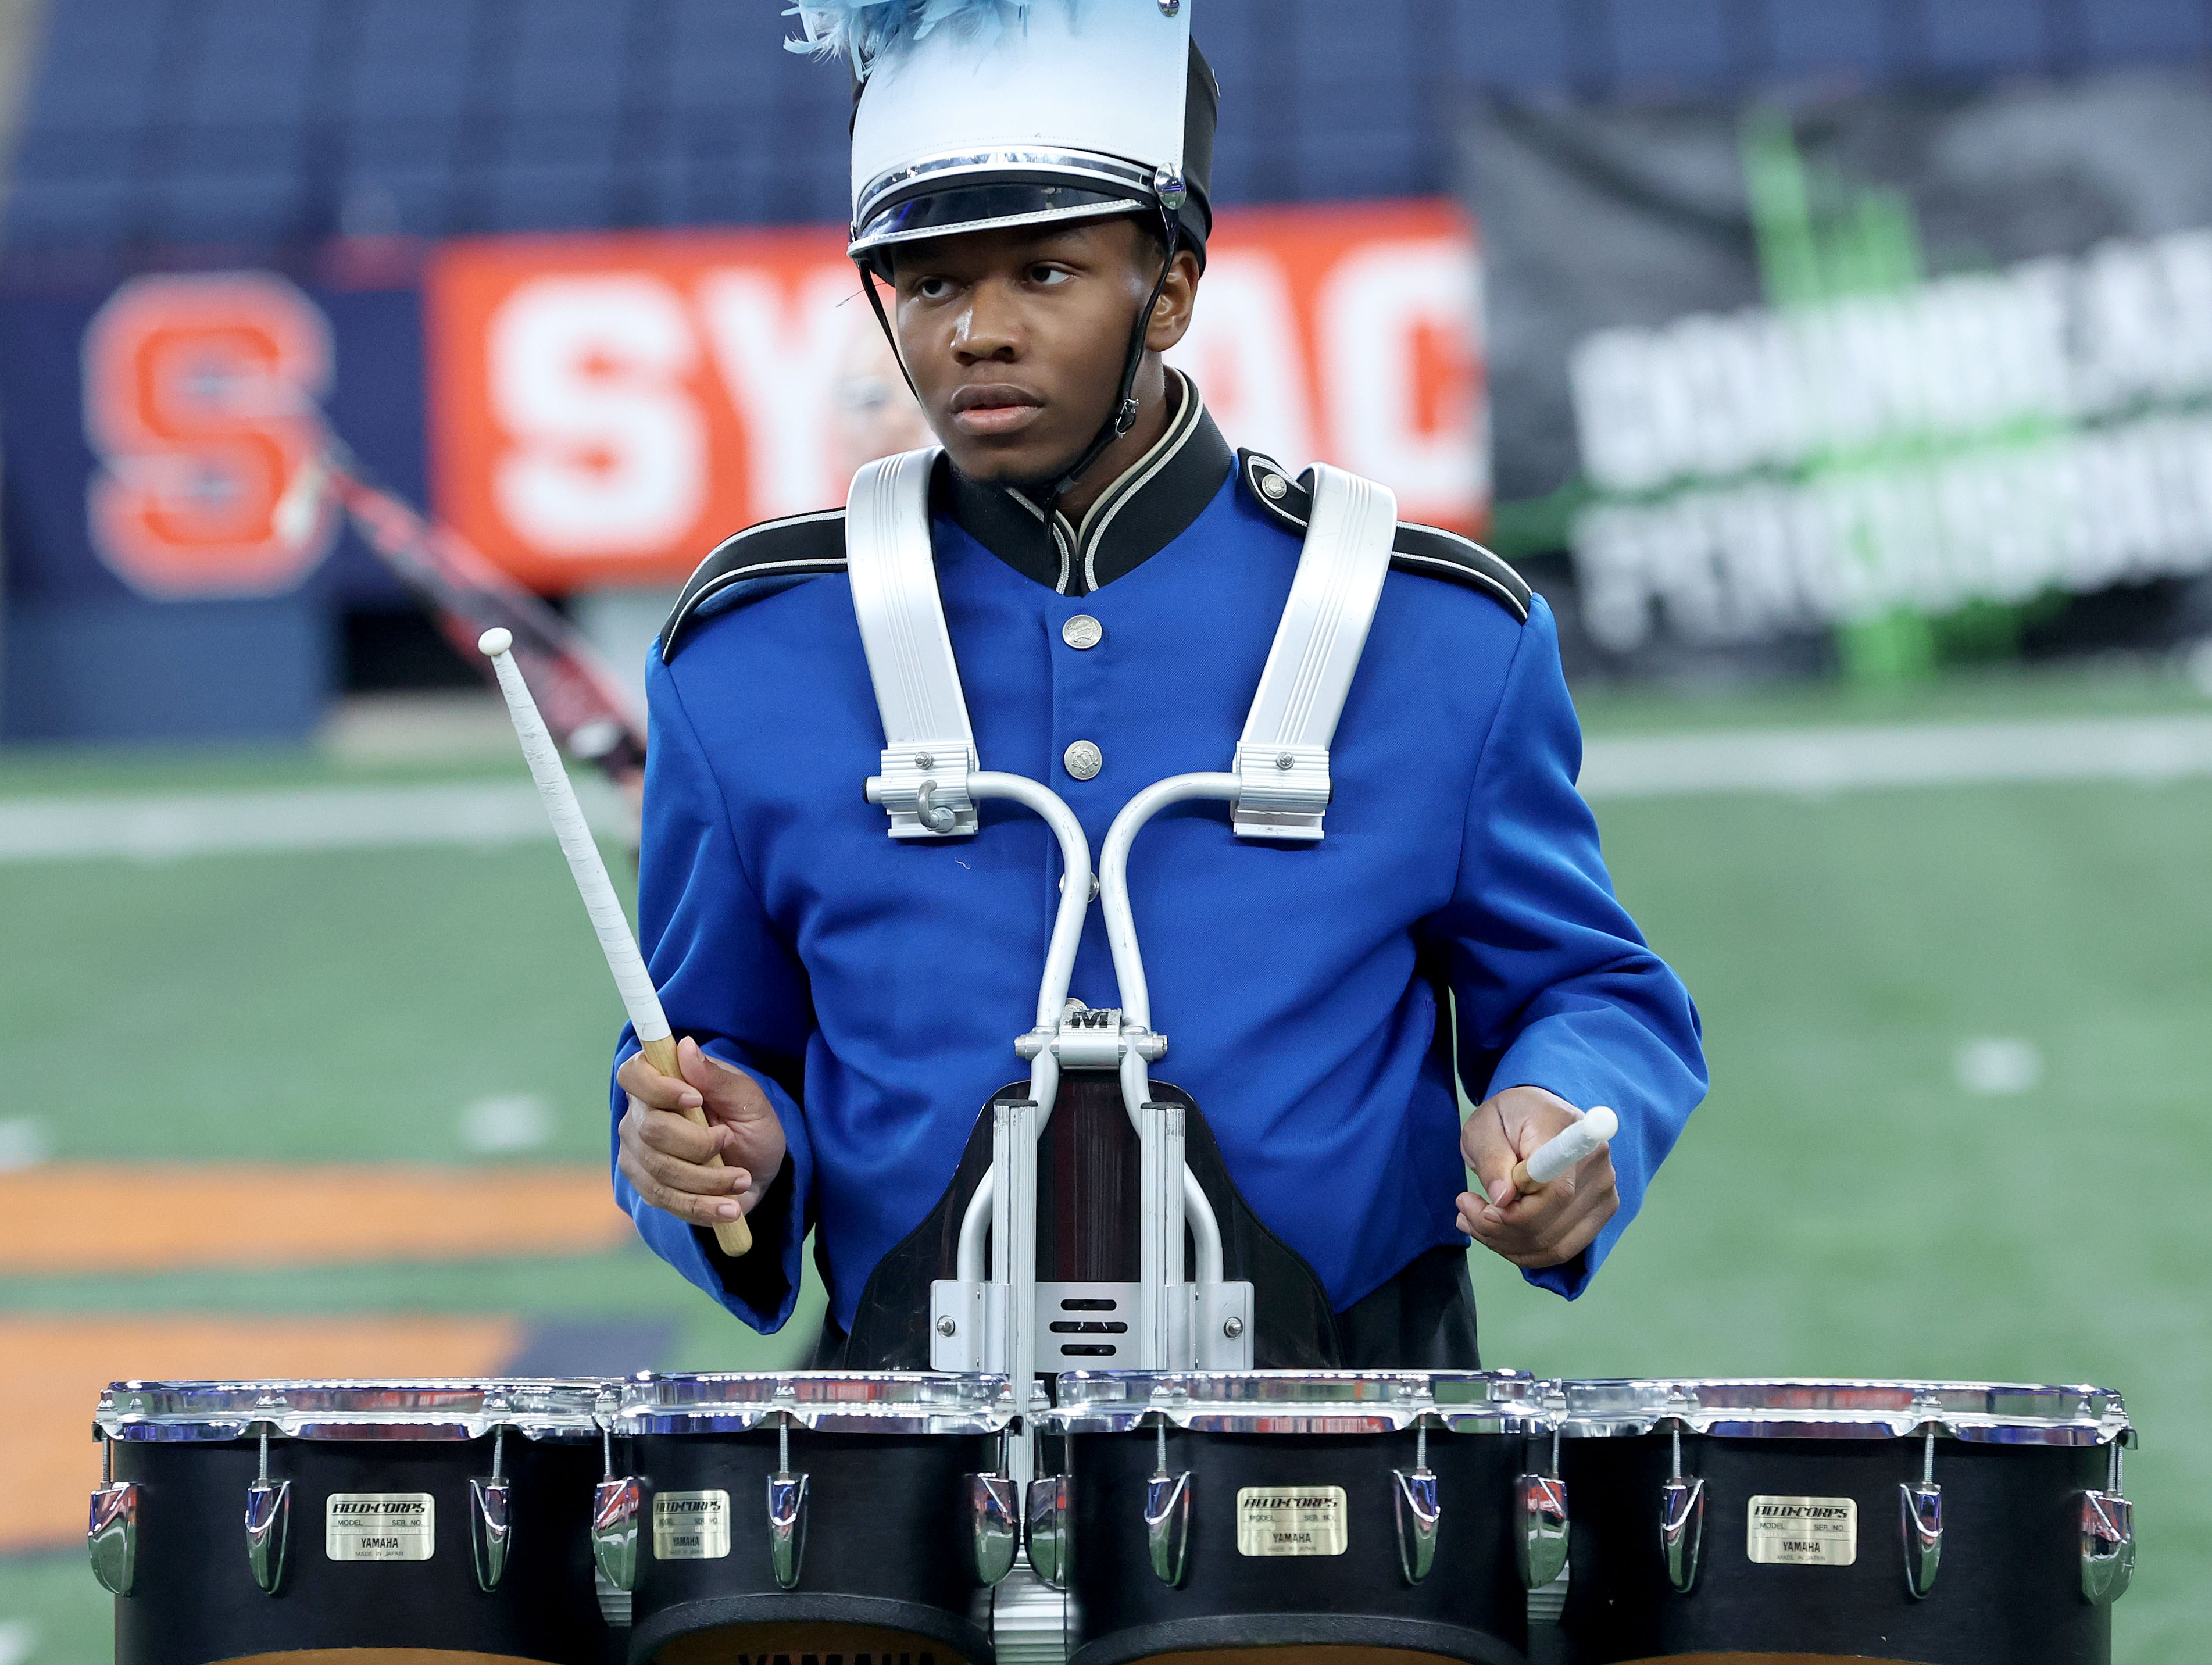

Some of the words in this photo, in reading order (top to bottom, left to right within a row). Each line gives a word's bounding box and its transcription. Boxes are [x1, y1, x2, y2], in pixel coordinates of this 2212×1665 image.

[361, 1538, 398, 1548] YAMAHA
[1273, 1533, 1312, 1543] YAMAHA
[1783, 1541, 1820, 1553] YAMAHA
